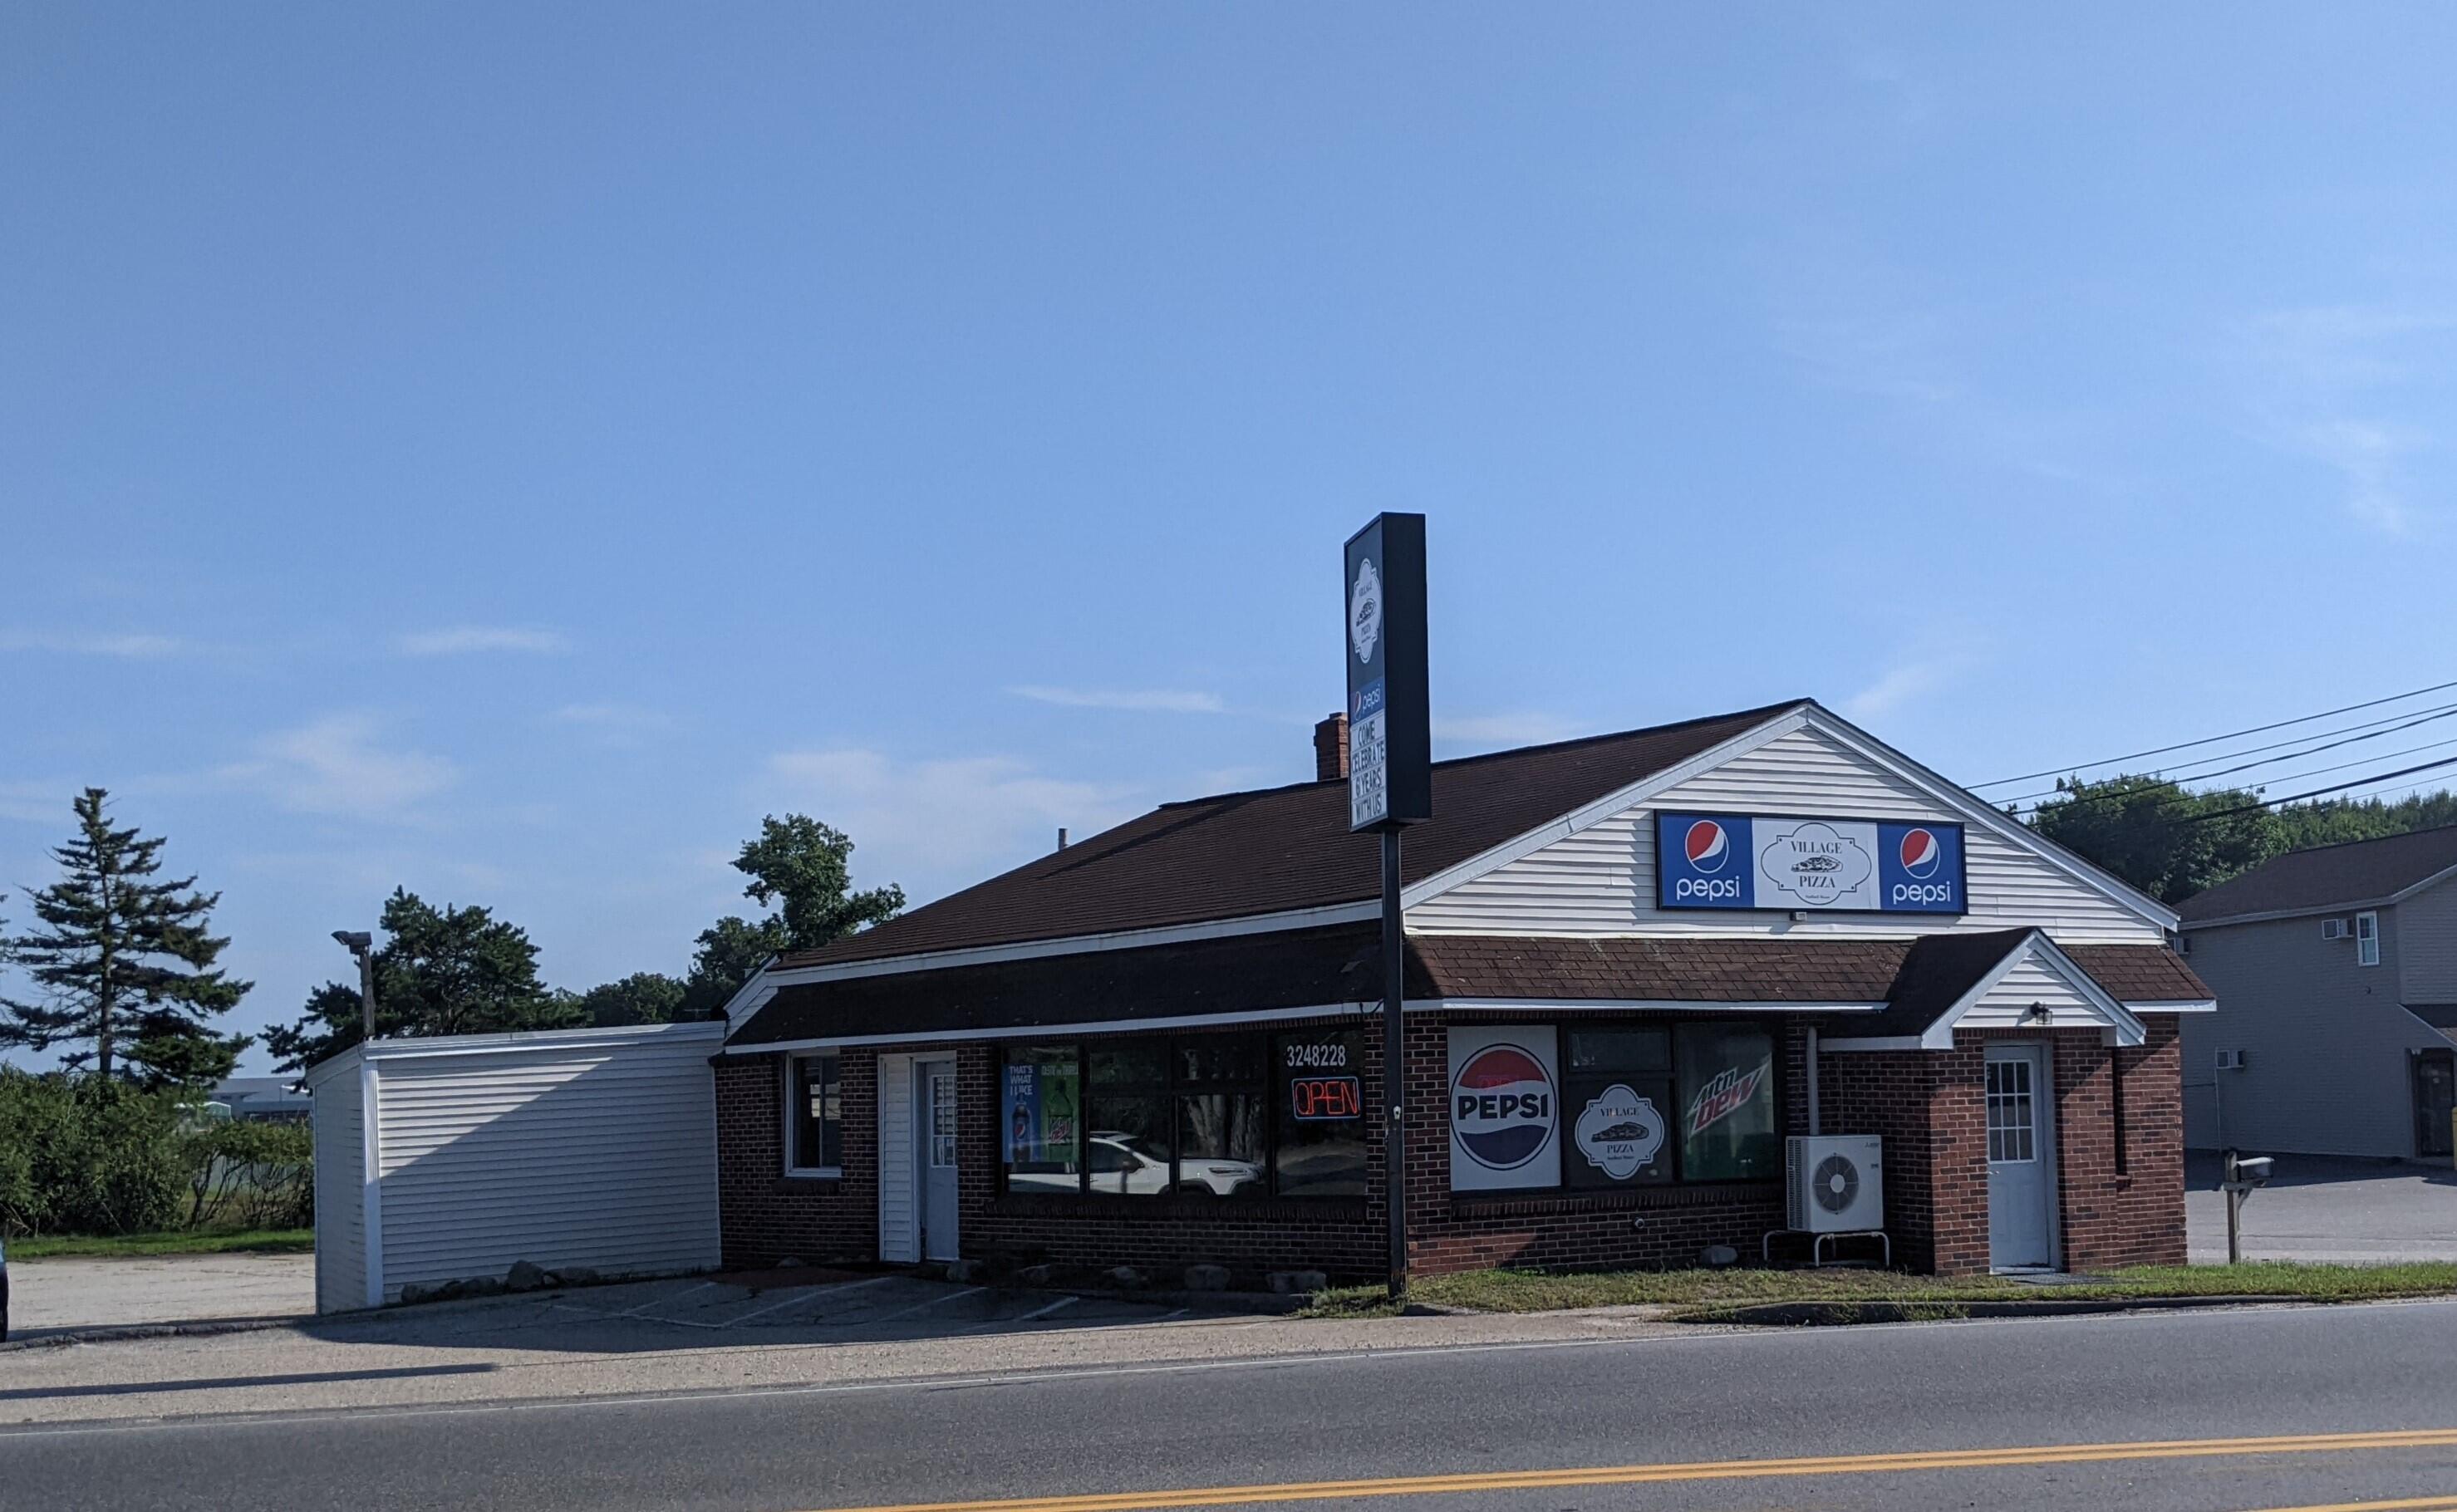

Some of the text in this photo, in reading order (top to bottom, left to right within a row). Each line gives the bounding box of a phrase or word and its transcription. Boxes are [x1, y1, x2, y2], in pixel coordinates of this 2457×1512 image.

[1362, 684, 1381, 714] pepsi
[1358, 720, 1375, 747] COME
[1352, 740, 1384, 774] CELEBRATE
[1361, 767, 1382, 794] YEARS
[1791, 841, 1842, 854] VILLAGE
[1676, 876, 1740, 901] pepsi
[1799, 875, 1835, 888] PIZZA
[1893, 881, 1950, 905] pepsi
[1286, 1044, 1346, 1067] 3248228
[1010, 1074, 1032, 1084] WHAT
[1295, 1081, 1358, 1116] OPEN
[1457, 1092, 1548, 1121] PEPSI
[1600, 1107, 1640, 1117] VILLAGE
[1607, 1143, 1634, 1154] PIZZA
